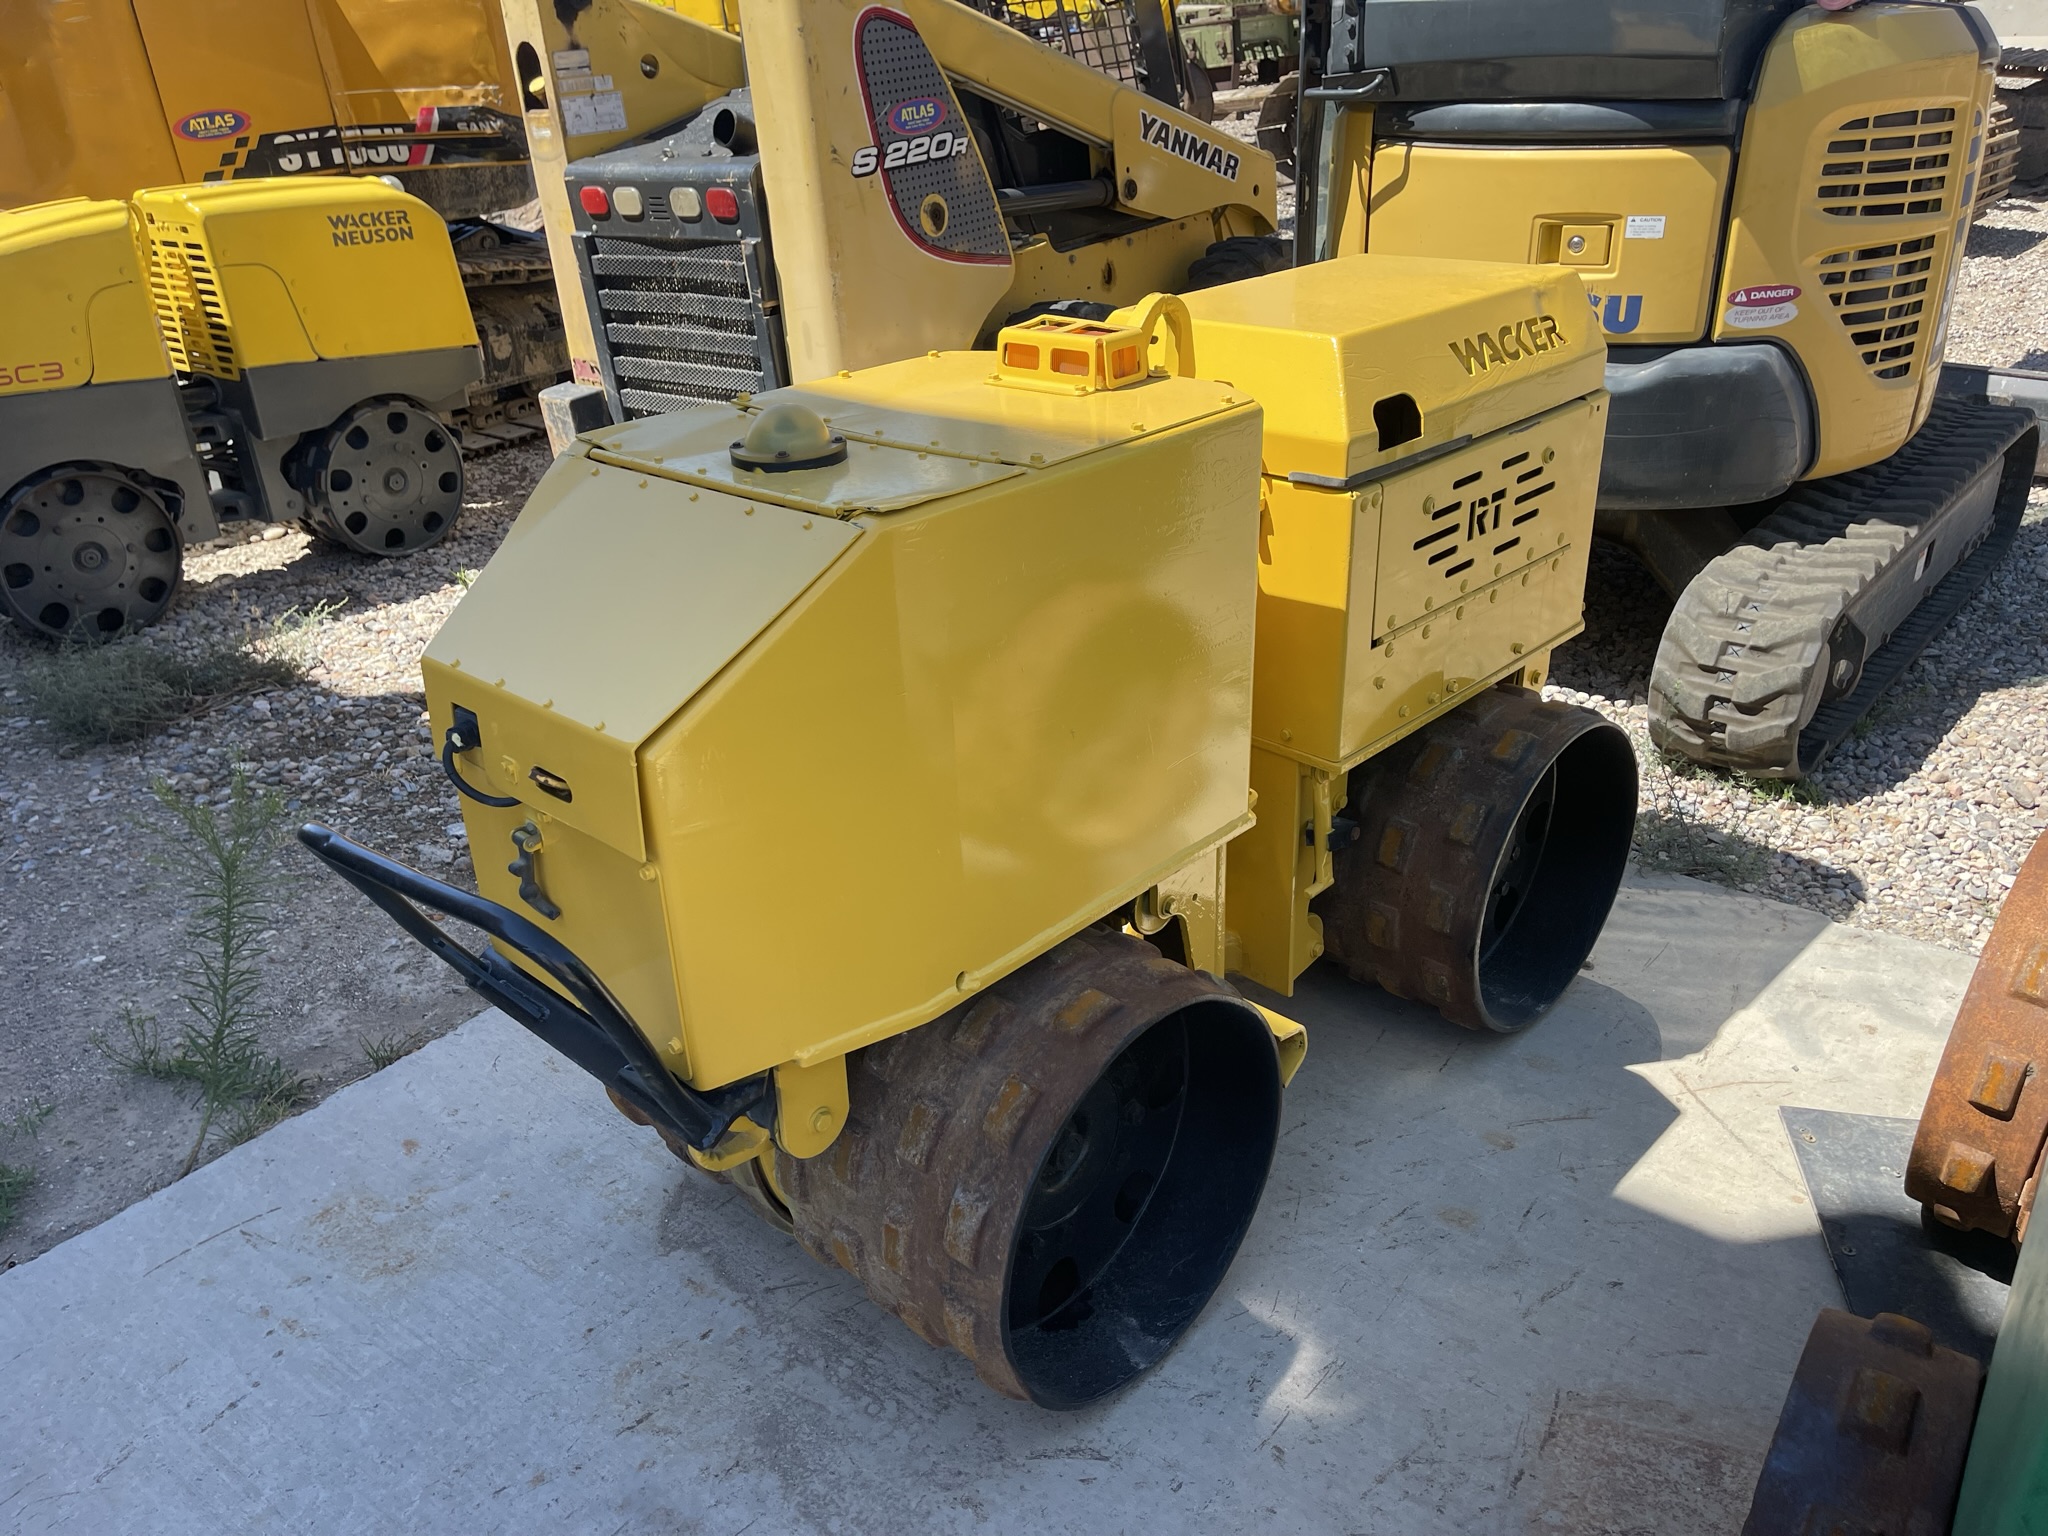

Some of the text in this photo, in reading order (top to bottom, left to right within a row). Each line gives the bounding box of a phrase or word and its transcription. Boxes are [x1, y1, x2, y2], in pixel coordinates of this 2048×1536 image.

[189, 113, 236, 132] ATLAS
[901, 103, 935, 123] ATLAS
[1140, 110, 1240, 181] YANMAR
[326, 209, 411, 230] WACKER
[332, 225, 414, 247] NEUSON
[1750, 288, 1795, 300] DANGER
[1734, 305, 1787, 317] KEEP OUT OF
[1734, 312, 1790, 324] TURNING AREA
[1448, 314, 1570, 377] WACKER
[1467, 487, 1508, 541] RT
